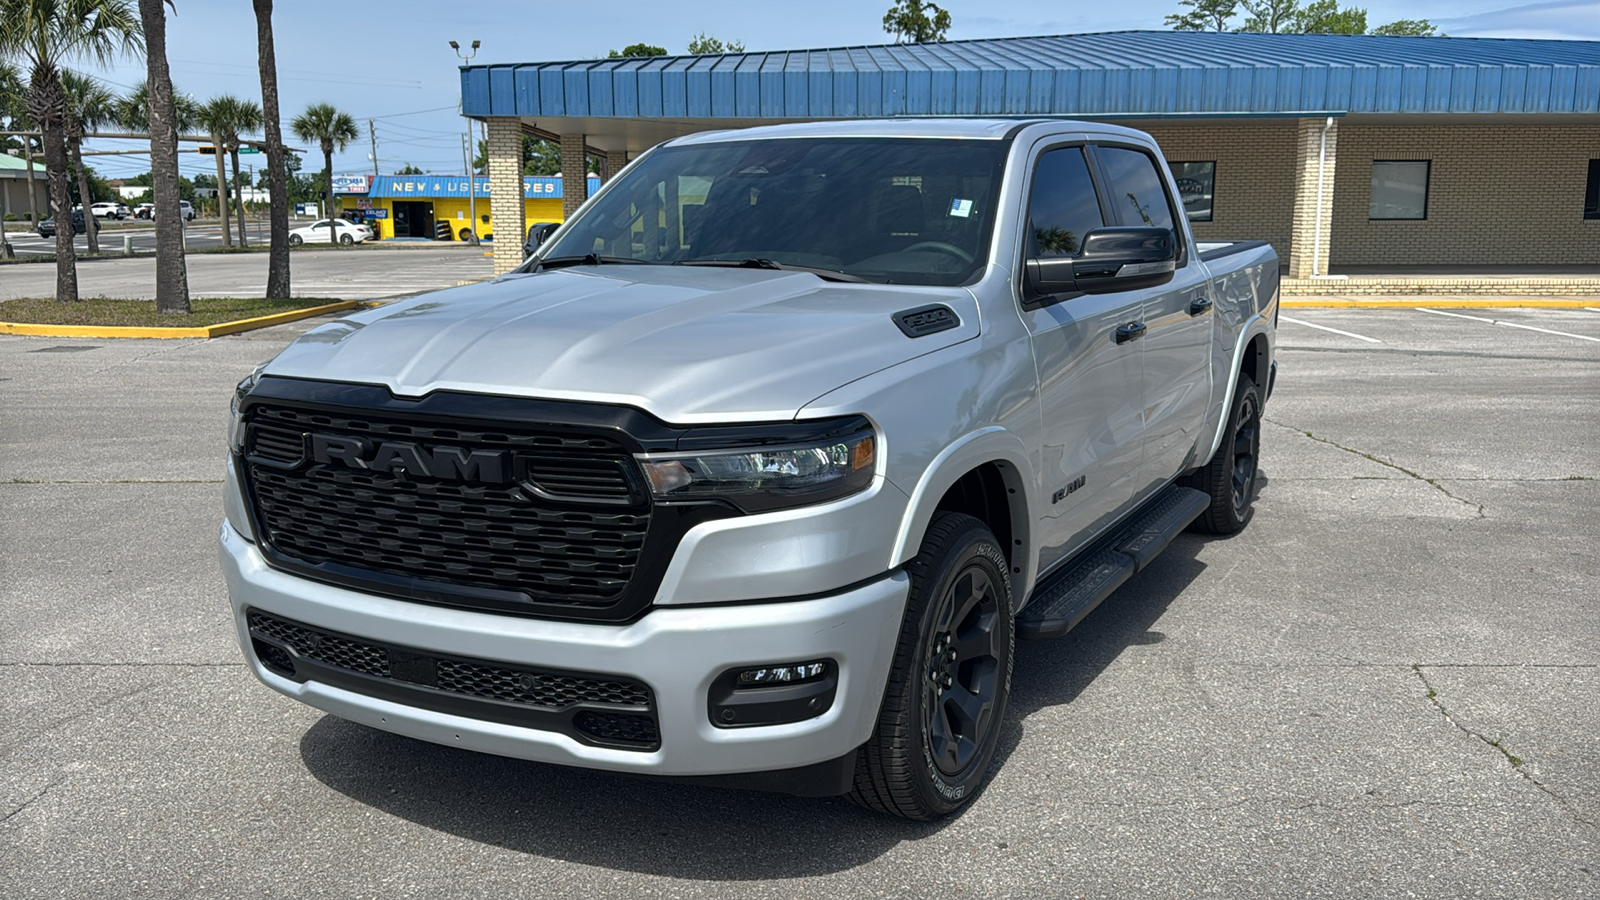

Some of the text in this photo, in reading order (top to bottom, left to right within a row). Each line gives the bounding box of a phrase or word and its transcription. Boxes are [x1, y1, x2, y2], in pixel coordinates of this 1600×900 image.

[393, 182, 555, 193] NEW & USED RES
[903, 309, 950, 328] 1500
[311, 432, 508, 483] RAM
[1051, 474, 1086, 505] RAM
